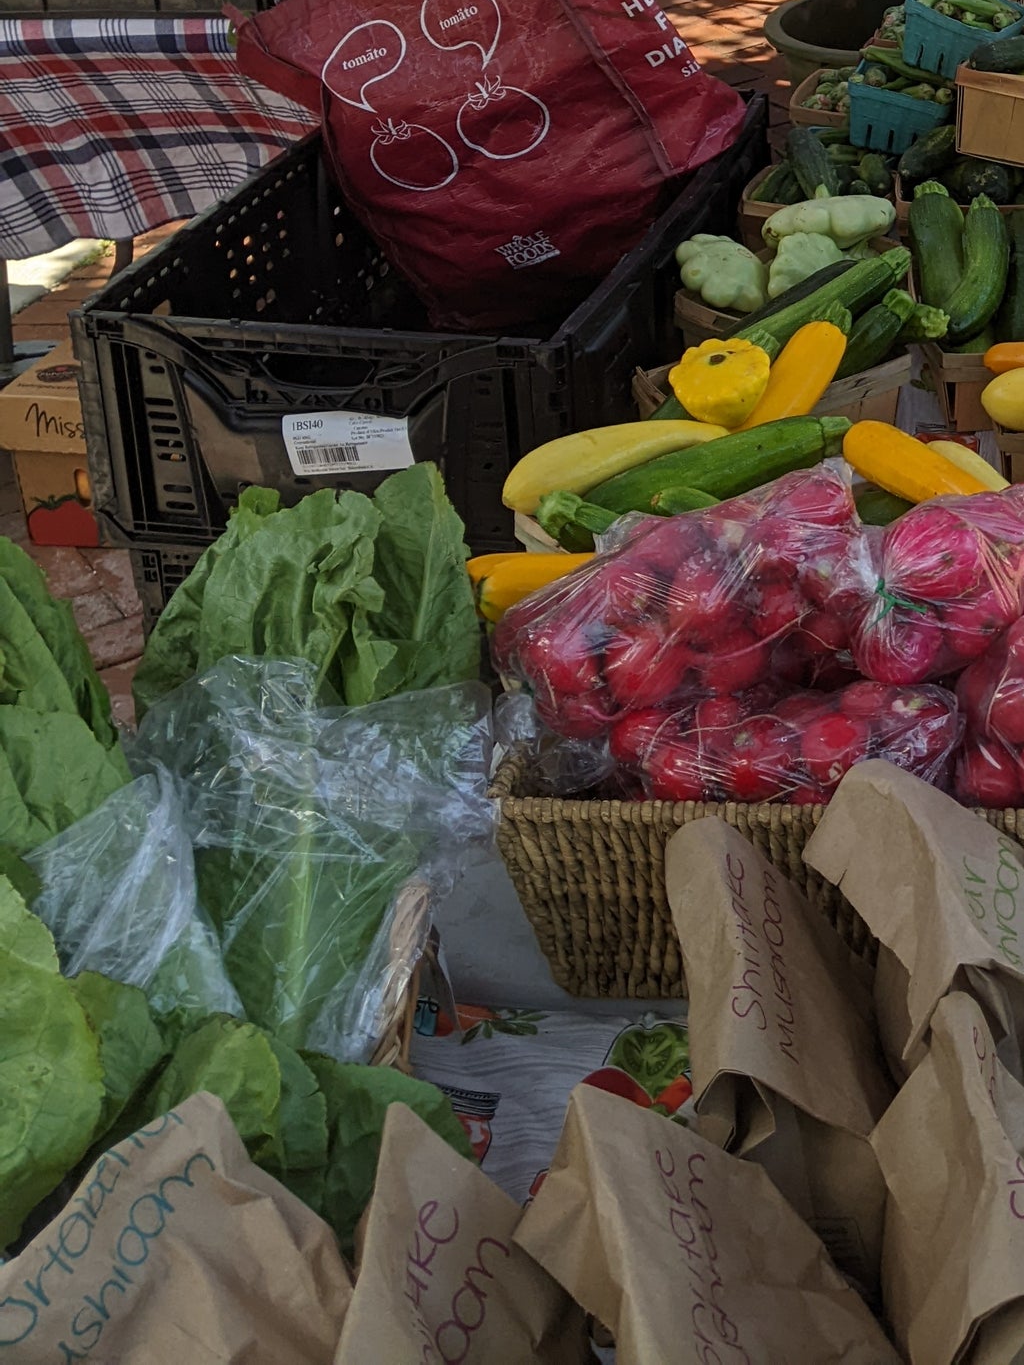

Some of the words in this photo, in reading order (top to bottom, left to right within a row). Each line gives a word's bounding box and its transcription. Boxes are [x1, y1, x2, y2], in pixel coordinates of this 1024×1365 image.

[439, 5, 479, 30] tomäto
[342, 47, 388, 70] tomāto
[644, 36, 688, 68] DIA
[493, 230, 550, 256] WHOLE
[505, 239, 556, 266] FOODS
[25, 402, 86, 439] Miss
